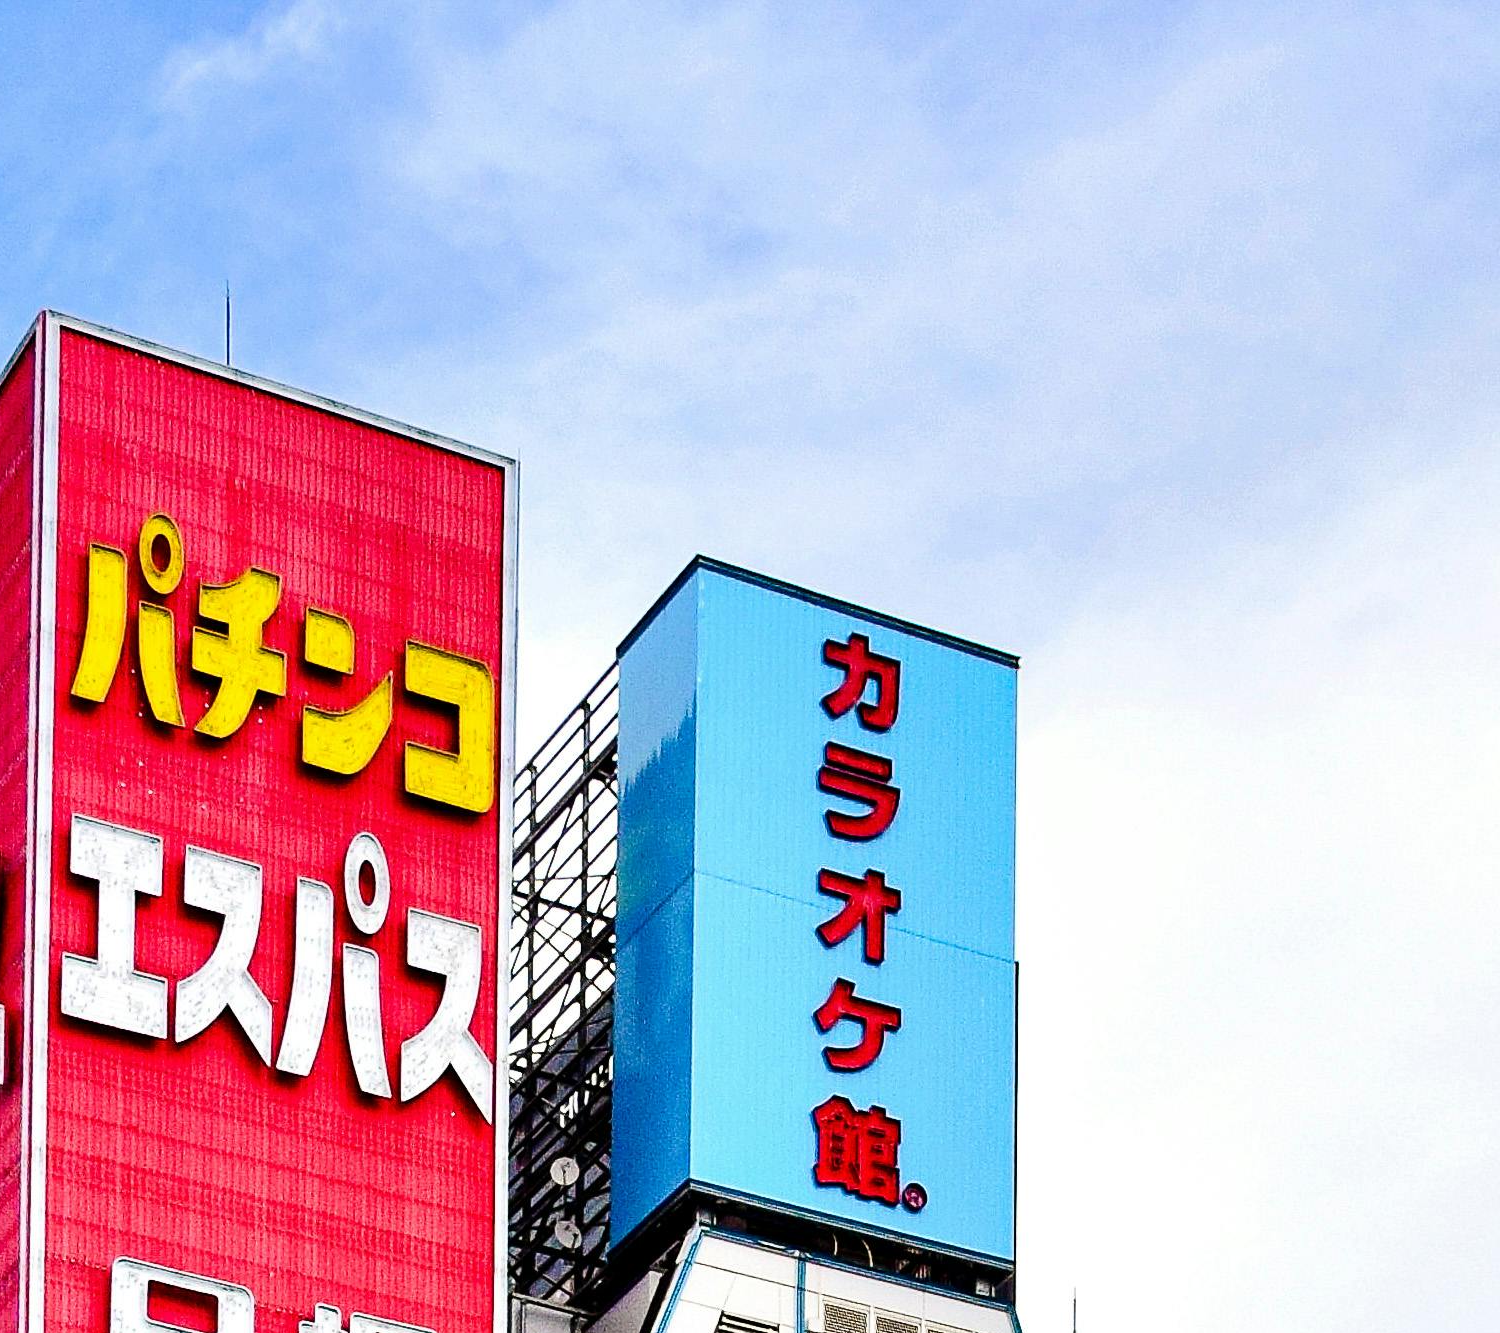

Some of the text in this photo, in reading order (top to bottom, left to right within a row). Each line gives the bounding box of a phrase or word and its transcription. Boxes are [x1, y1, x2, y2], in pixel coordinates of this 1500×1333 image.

[71, 512, 494, 814] パチンコ
[60, 813, 494, 1125] エスパス
[811, 632, 902, 1205] カラオケ館
